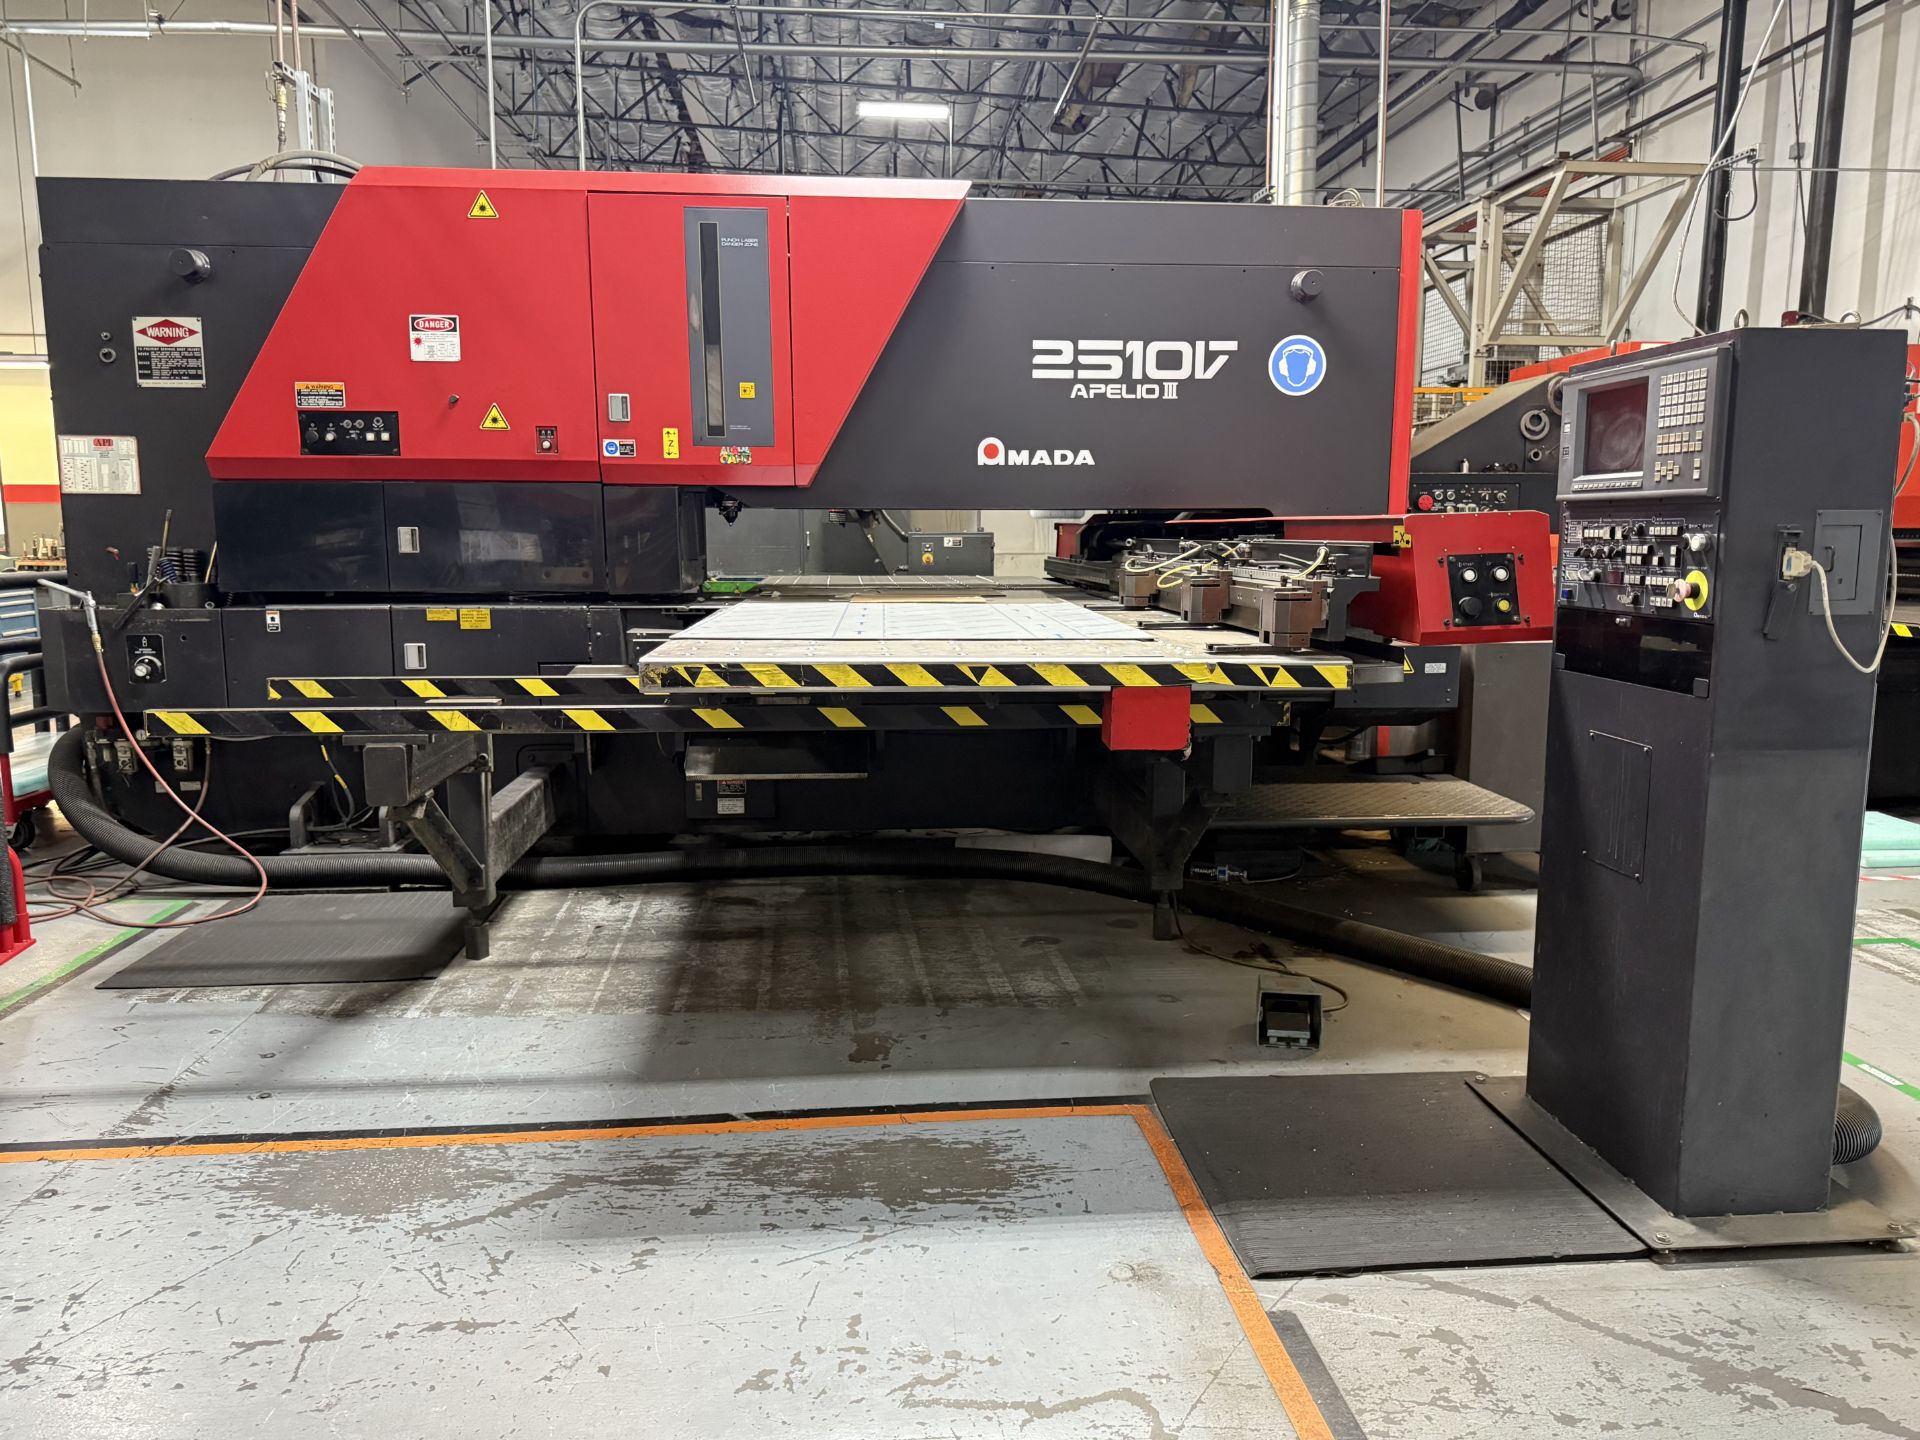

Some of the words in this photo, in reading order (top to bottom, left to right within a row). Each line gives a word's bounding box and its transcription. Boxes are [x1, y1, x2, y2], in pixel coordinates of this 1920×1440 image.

[419, 320, 450, 328] DANGER
[146, 327, 190, 338] WARNING
[1070, 383, 1160, 399] APELIO
[1162, 382, 1178, 400] III
[977, 436, 1096, 466] AMADA
